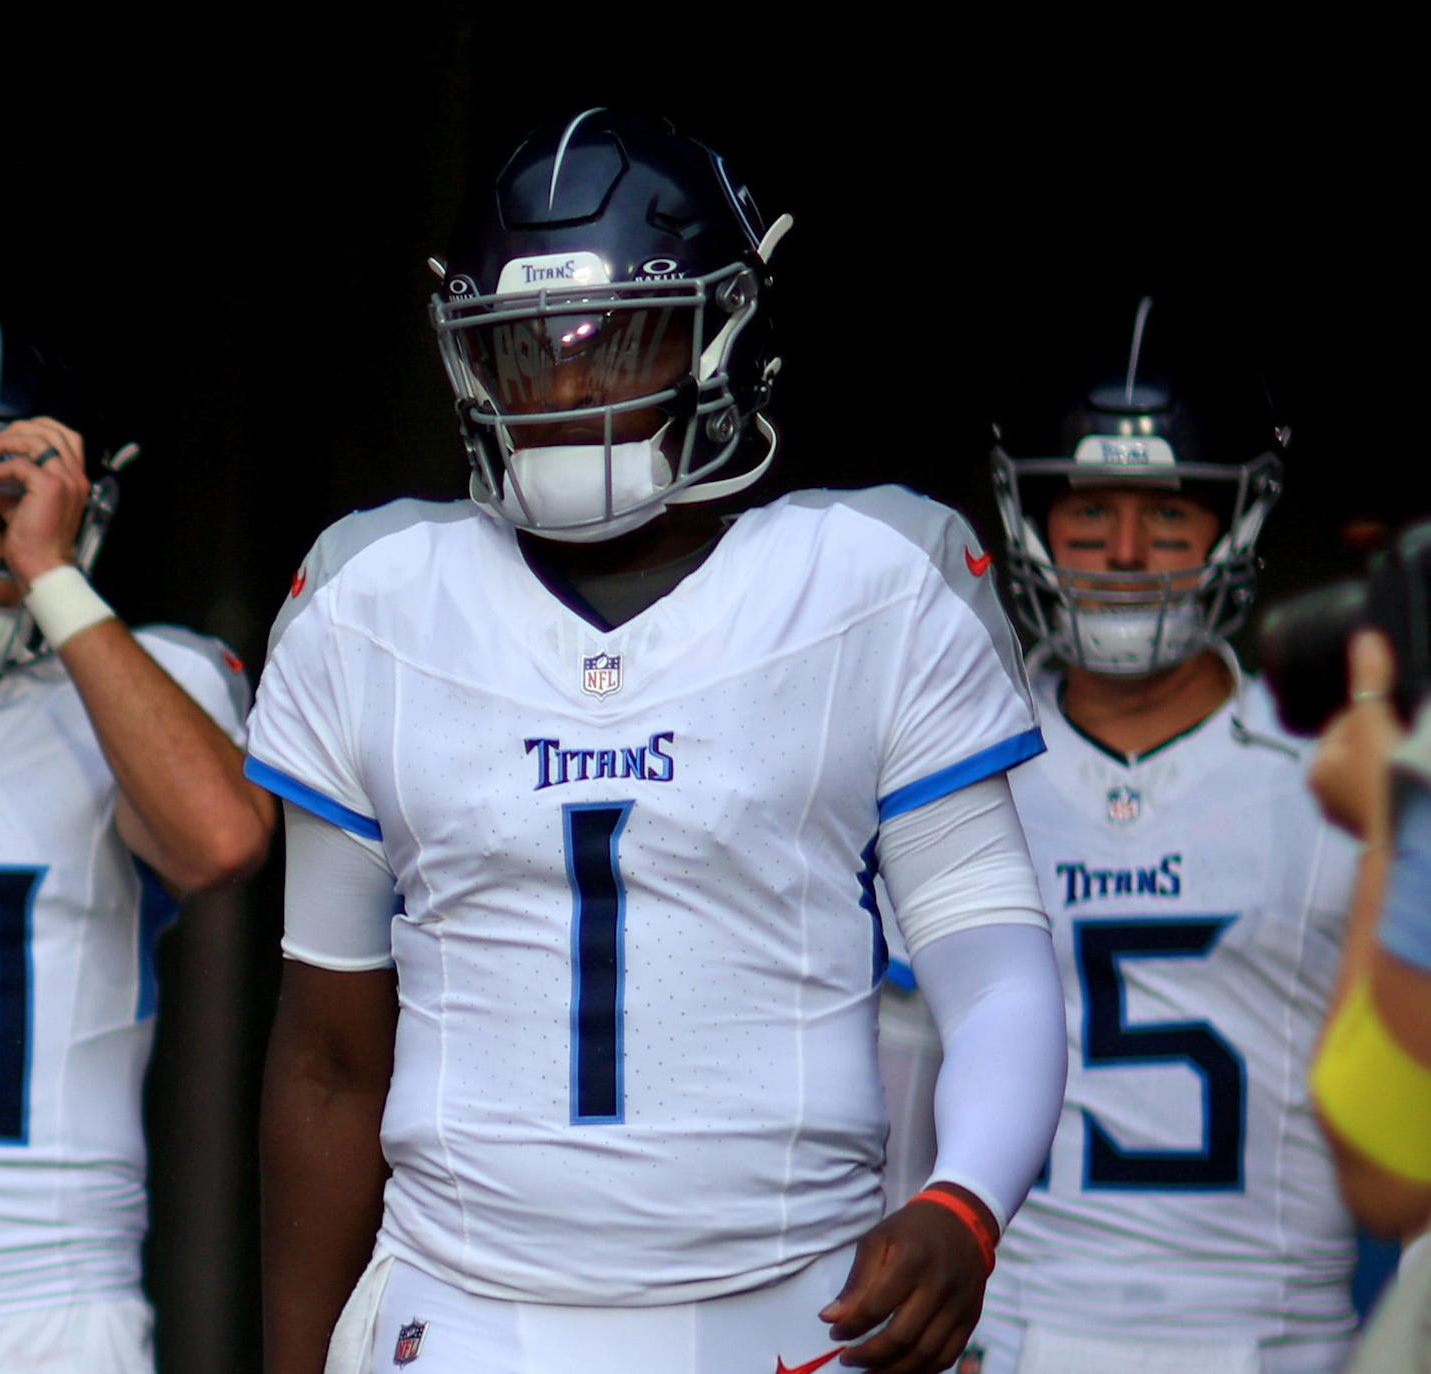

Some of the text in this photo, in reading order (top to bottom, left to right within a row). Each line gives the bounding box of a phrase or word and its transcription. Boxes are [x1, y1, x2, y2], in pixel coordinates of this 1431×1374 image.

[522, 260, 575, 283] TITANS
[586, 671, 617, 690] NFL
[524, 731, 674, 791] TITANS
[1056, 853, 1183, 908] TITANS
[561, 799, 637, 1126] 1
[1032, 912, 1248, 1193] 5
